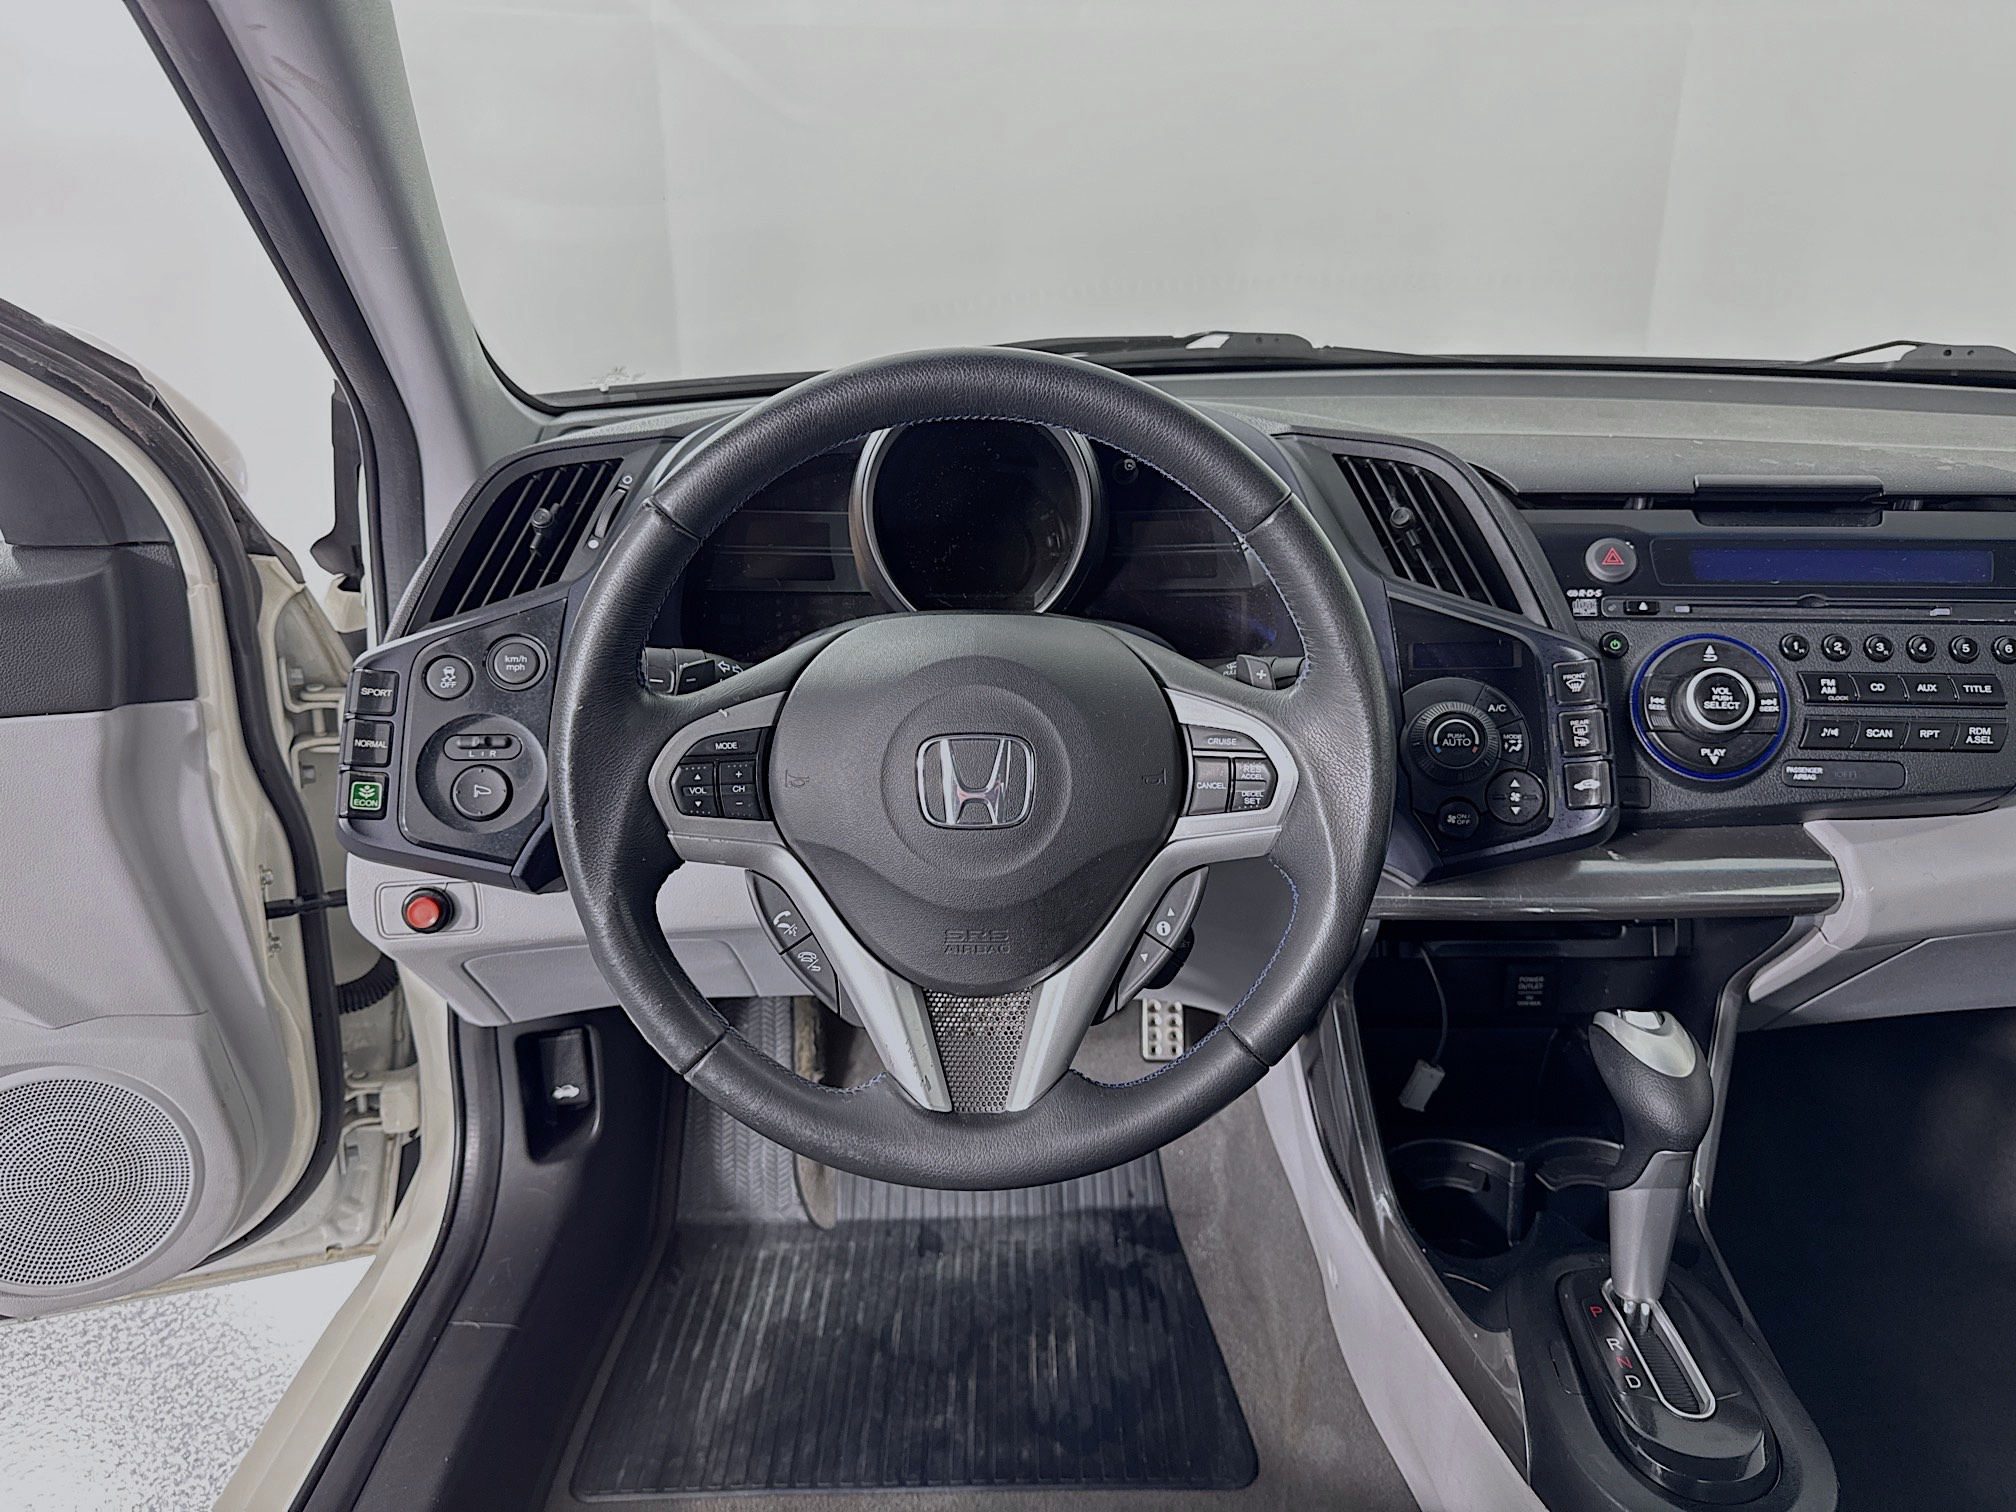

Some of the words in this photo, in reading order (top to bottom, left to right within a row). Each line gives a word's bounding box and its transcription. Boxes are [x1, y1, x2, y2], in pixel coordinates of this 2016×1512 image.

[1793, 642, 1799, 650] 1
[1833, 642, 1842, 651] 2
[1876, 642, 1884, 651] 3
[1918, 643, 1928, 652] 4
[1961, 644, 1970, 653] 5
[2005, 644, 2014, 653] 6
[504, 655, 528, 663] km/h
[505, 663, 526, 671] mph
[1562, 672, 1587, 681] FRONT
[1820, 678, 1836, 687] FM
[1869, 683, 1886, 691] CD
[360, 687, 393, 697] SPORT
[1711, 687, 1732, 695] VOL
[1820, 686, 1837, 695] AM
[1916, 684, 1938, 692] AUX
[1963, 685, 1993, 693] TITLE
[1487, 704, 1507, 713] A/C
[1703, 701, 1741, 710] SELECT
[1865, 729, 1893, 738] SCAN
[1919, 729, 1940, 738] RPT
[1968, 727, 1991, 736] RDM
[354, 739, 388, 748] NORMAL
[715, 742, 738, 750] MODE
[1207, 737, 1238, 746] CRUISE
[1441, 738, 1472, 748] AUTO
[468, 750, 475, 758] L
[1700, 748, 1727, 757] PLAY
[1243, 765, 1262, 773] RES
[1785, 765, 1823, 775] PASSENGER
[1792, 773, 1817, 781] AIRBAG
[732, 785, 746, 793] CH
[1196, 781, 1227, 790] CANCEL
[353, 799, 378, 807] ECON
[1243, 797, 1261, 805] SET
[944, 929, 1010, 943] SRS
[943, 944, 1011, 955] AIRBAG
[1589, 1306, 1603, 1318] P
[1606, 1337, 1624, 1351] R
[1615, 1355, 1633, 1369] N
[1625, 1374, 1642, 1389] D
